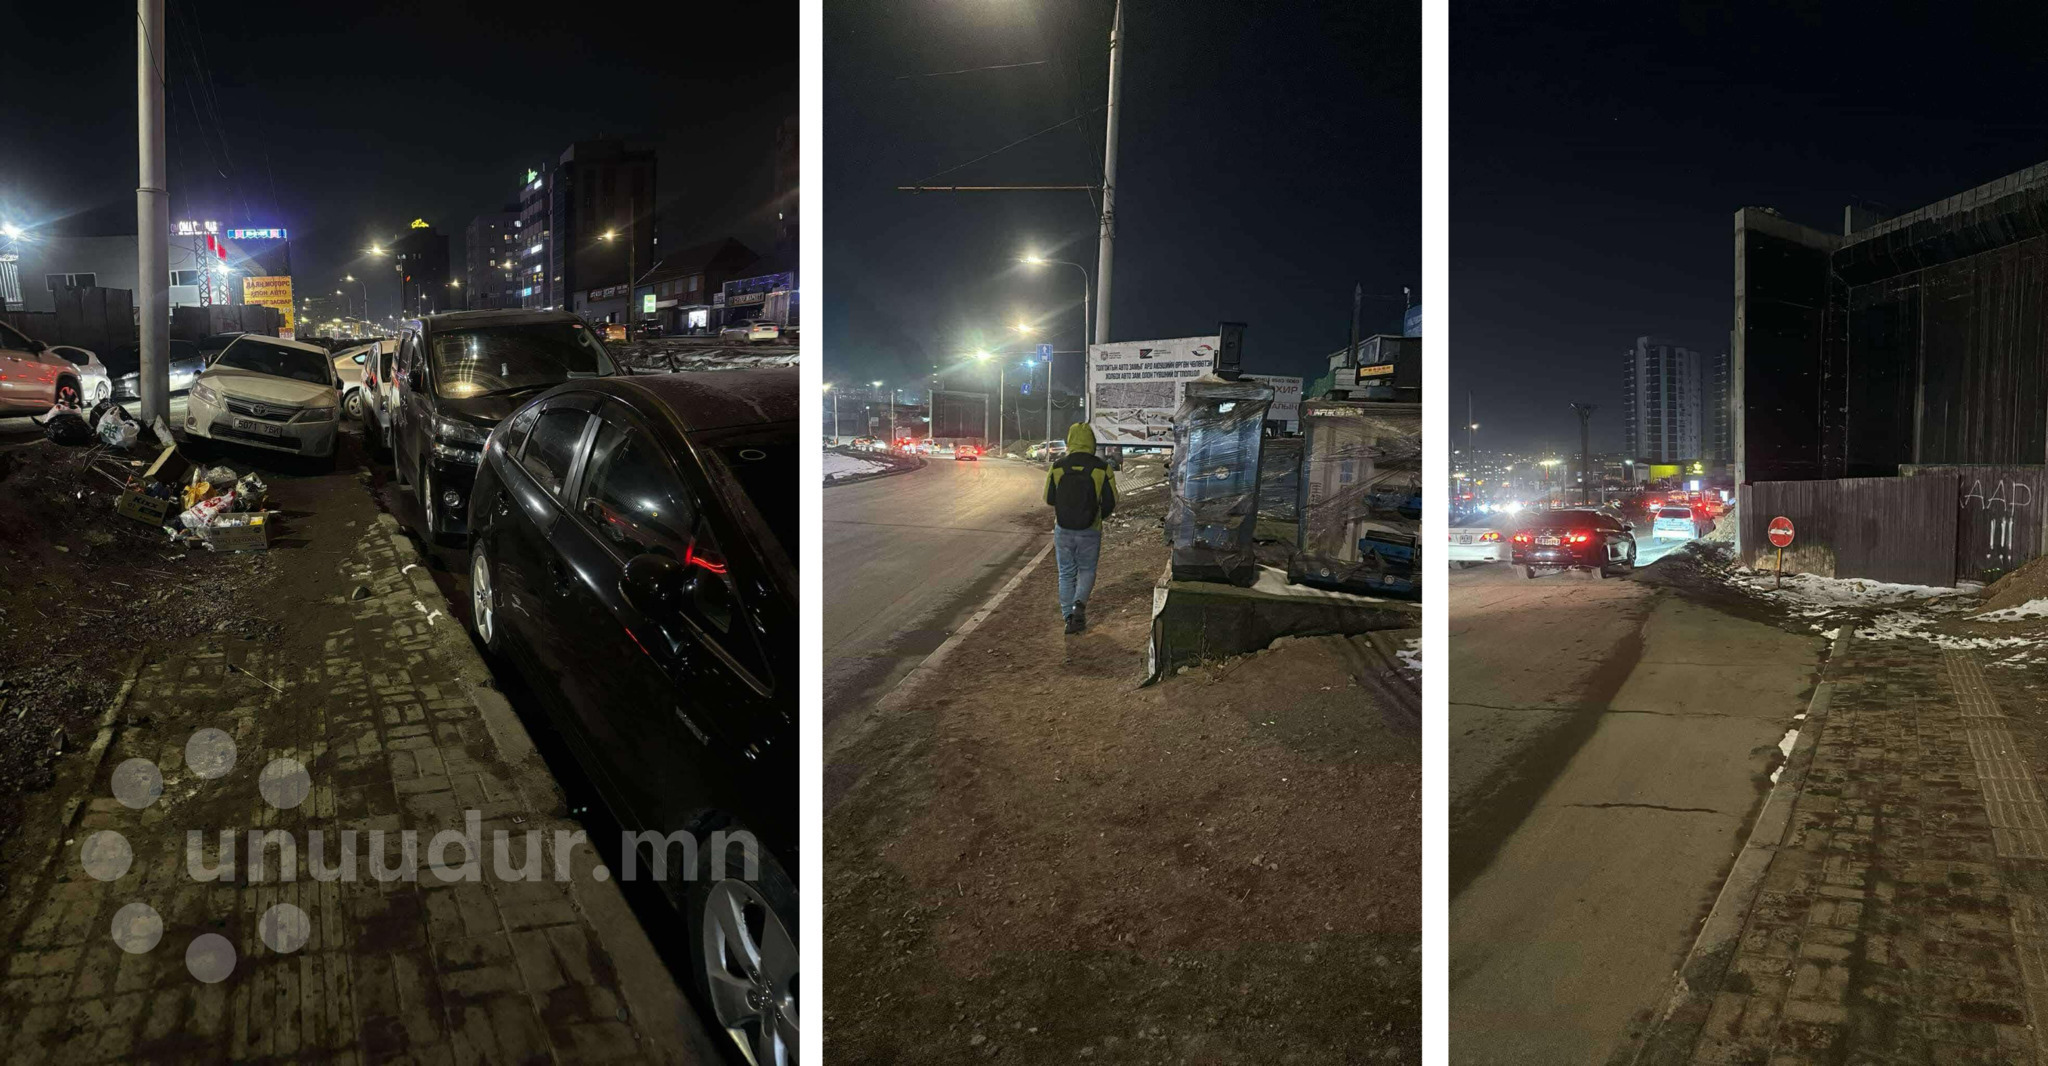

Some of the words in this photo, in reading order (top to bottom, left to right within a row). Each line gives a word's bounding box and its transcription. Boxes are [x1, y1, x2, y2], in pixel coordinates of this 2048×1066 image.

[1118, 363, 1129, 371] АВТО
[239, 420, 257, 431] 5071
[264, 424, 279, 434] УБИ
[133, 496, 159, 509] Kixx
